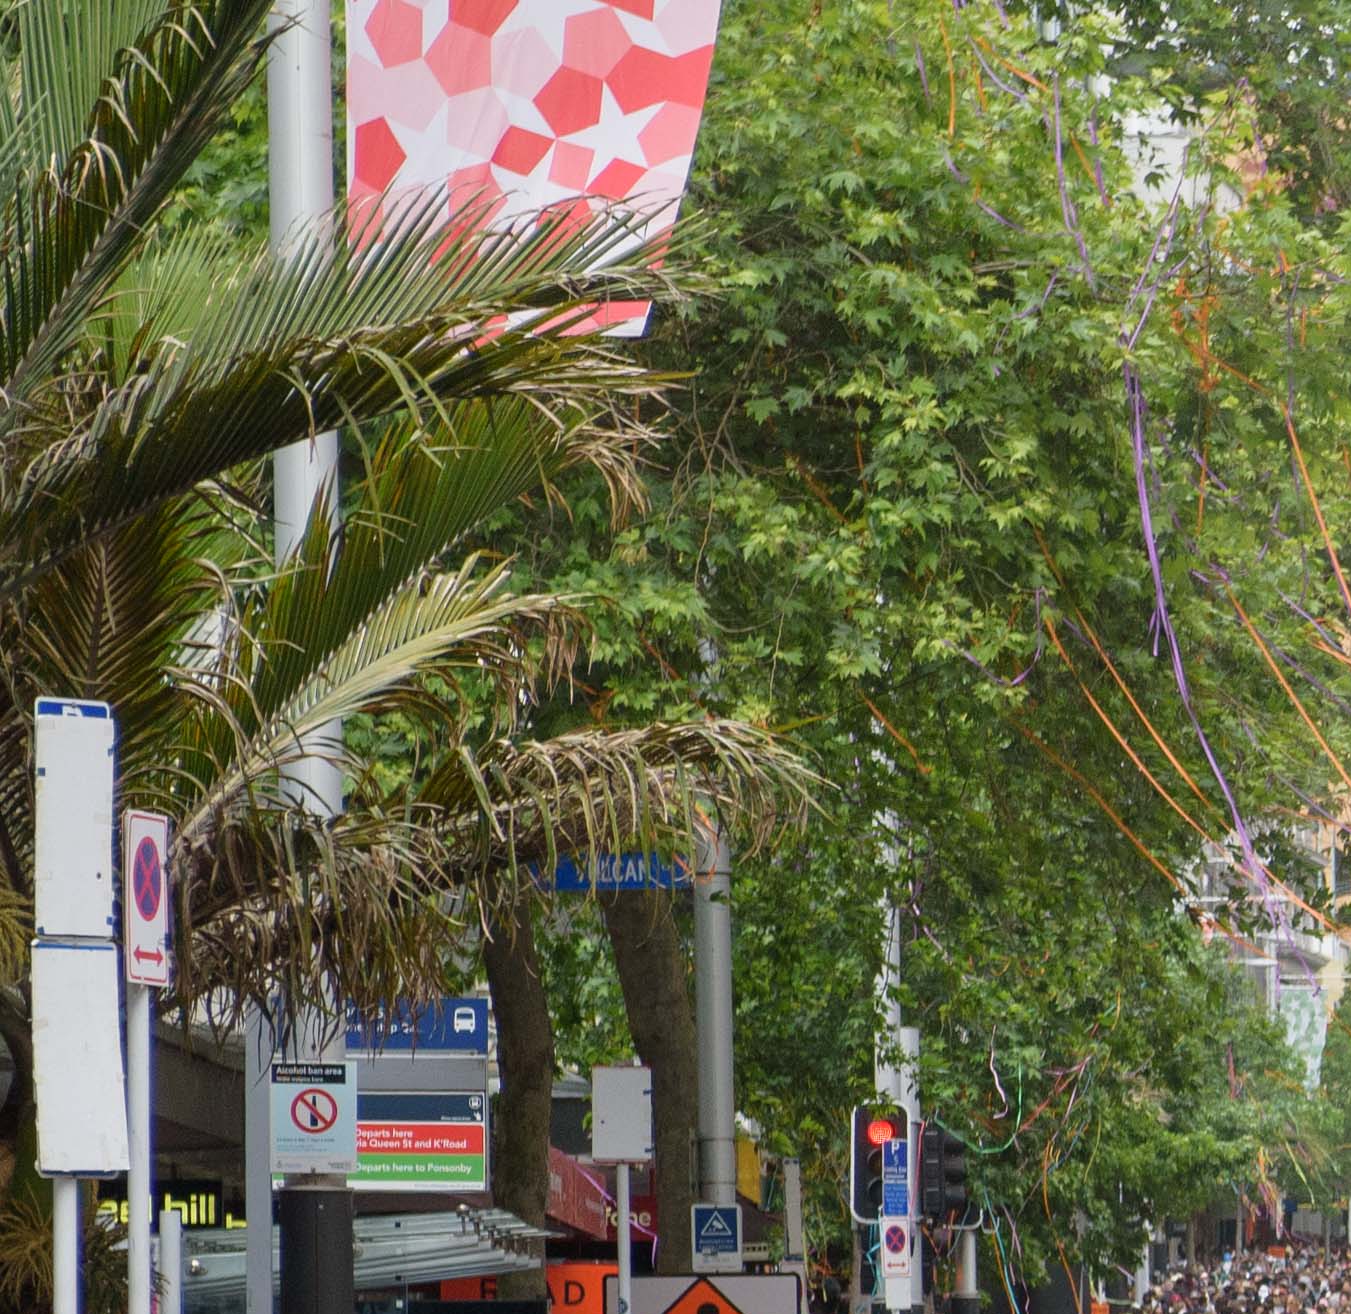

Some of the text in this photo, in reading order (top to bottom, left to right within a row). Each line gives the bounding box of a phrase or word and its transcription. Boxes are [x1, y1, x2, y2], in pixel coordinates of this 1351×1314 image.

[276, 1066, 306, 1075] Alcohol
[308, 1066, 323, 1075] ban
[355, 1128, 413, 1139] Departs here
[369, 1139, 401, 1149] Queen
[402, 1139, 412, 1148] St
[414, 1140, 432, 1149] and
[434, 1140, 467, 1149] K'Road
[355, 1162, 390, 1174] Departs
[392, 1162, 413, 1172] here
[416, 1163, 426, 1172] to
[427, 1162, 472, 1175] Ponsonby
[165, 1192, 215, 1224] hill
